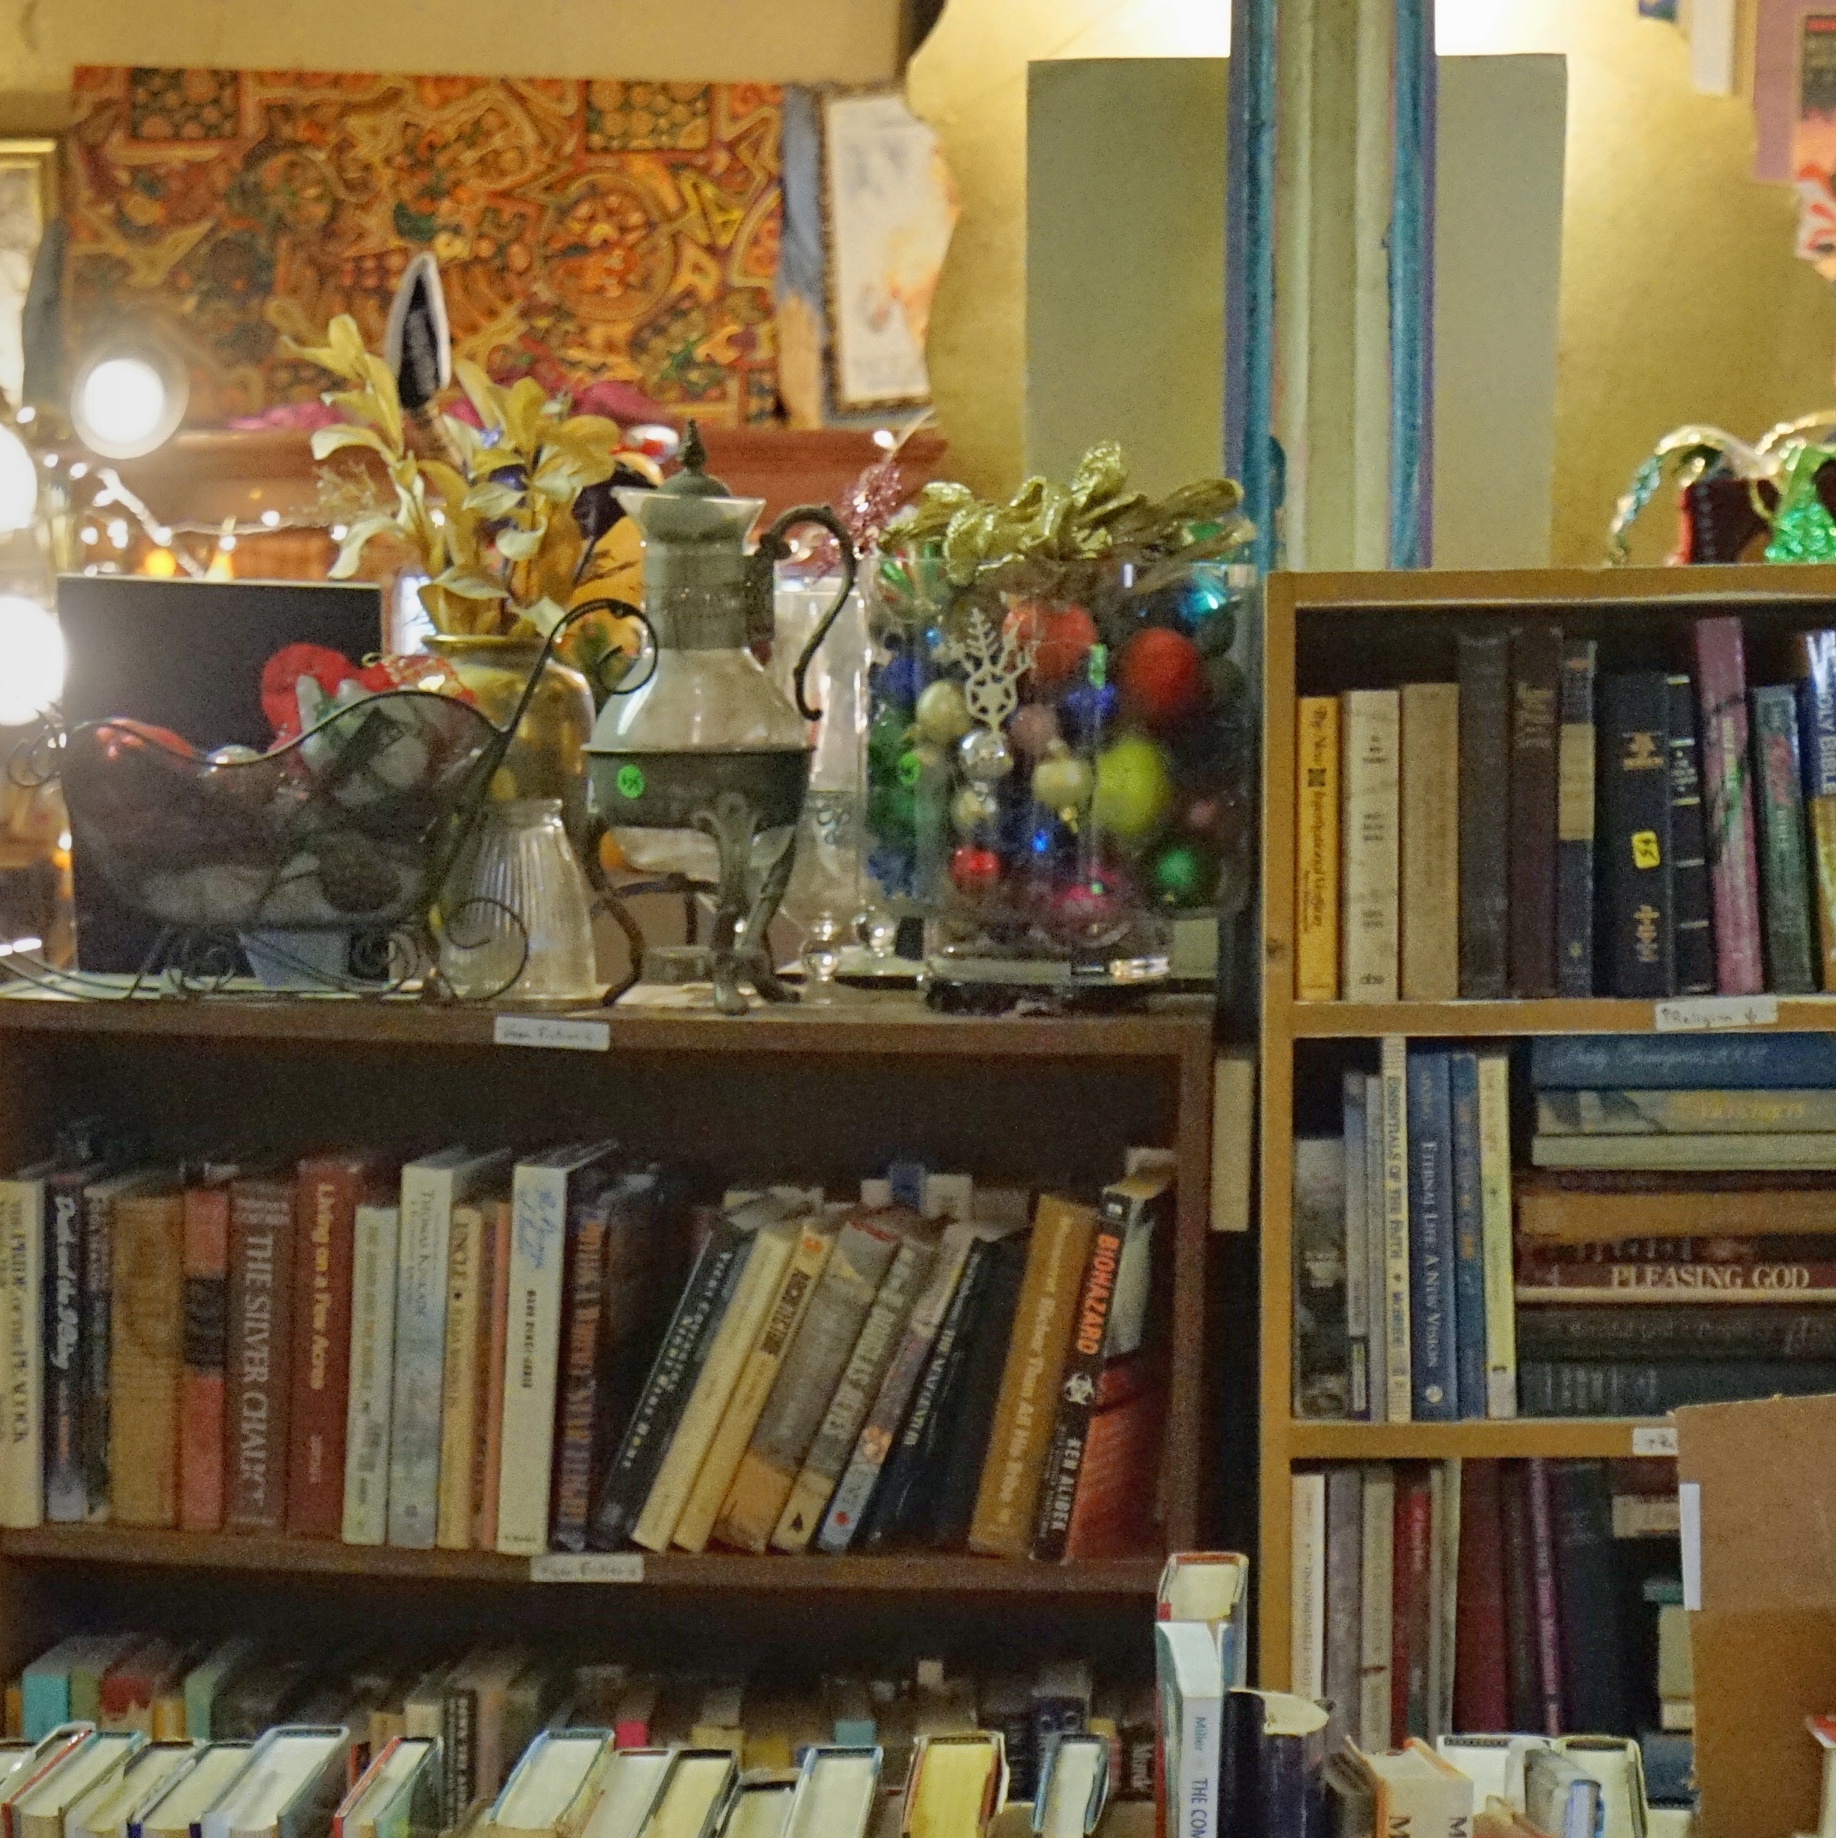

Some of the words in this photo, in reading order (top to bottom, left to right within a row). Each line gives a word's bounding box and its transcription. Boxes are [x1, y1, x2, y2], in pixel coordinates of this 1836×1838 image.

[1612, 1265, 1743, 1288] PLEASING
[1752, 1265, 1810, 1288] GOD
[1077, 1234, 1121, 1355] BIOHAZARD
[1191, 1780, 1208, 1804] THE
